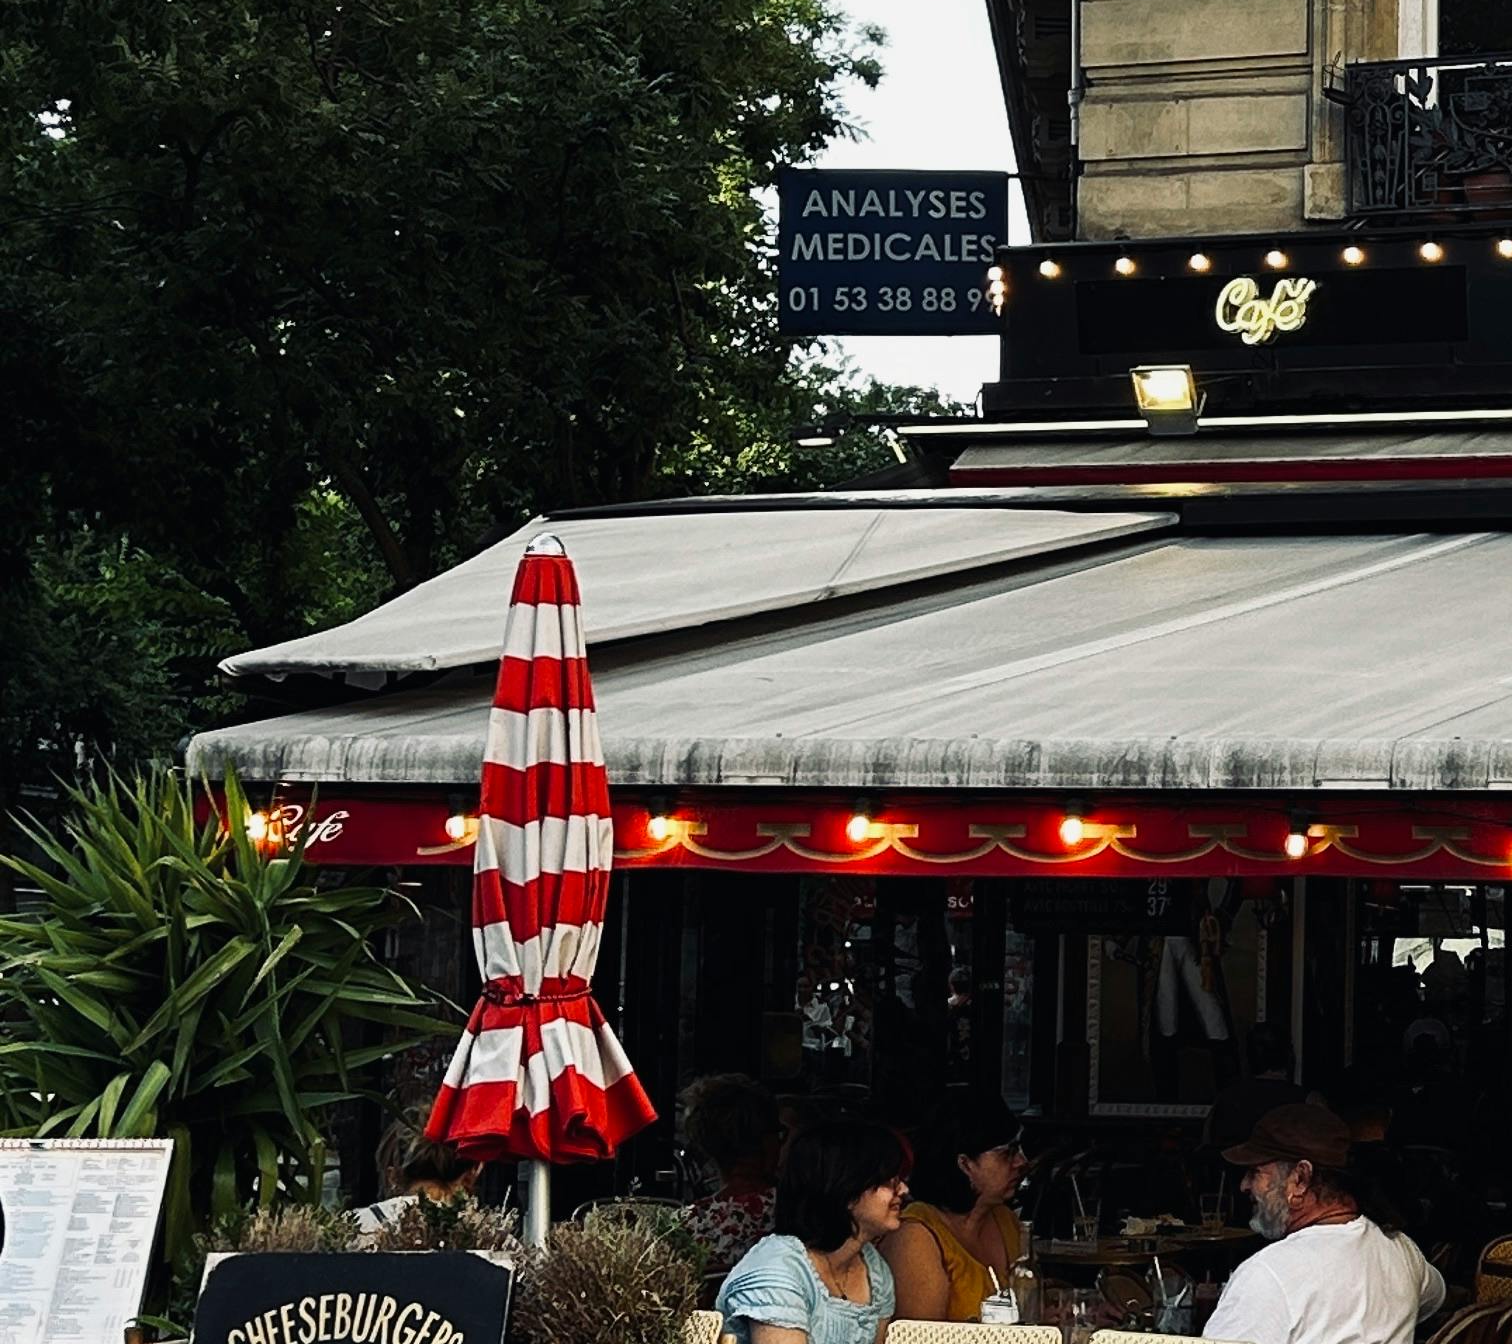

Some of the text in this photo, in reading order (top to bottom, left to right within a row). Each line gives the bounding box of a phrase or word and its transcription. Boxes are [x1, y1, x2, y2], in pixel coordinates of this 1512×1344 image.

[801, 188, 988, 221] ANALYSES
[790, 232, 998, 264] MEDICALES
[789, 286, 820, 313] 01
[832, 286, 868, 313] 53
[877, 286, 913, 313] 38
[921, 286, 957, 313] 88
[1214, 275, 1320, 347] Café
